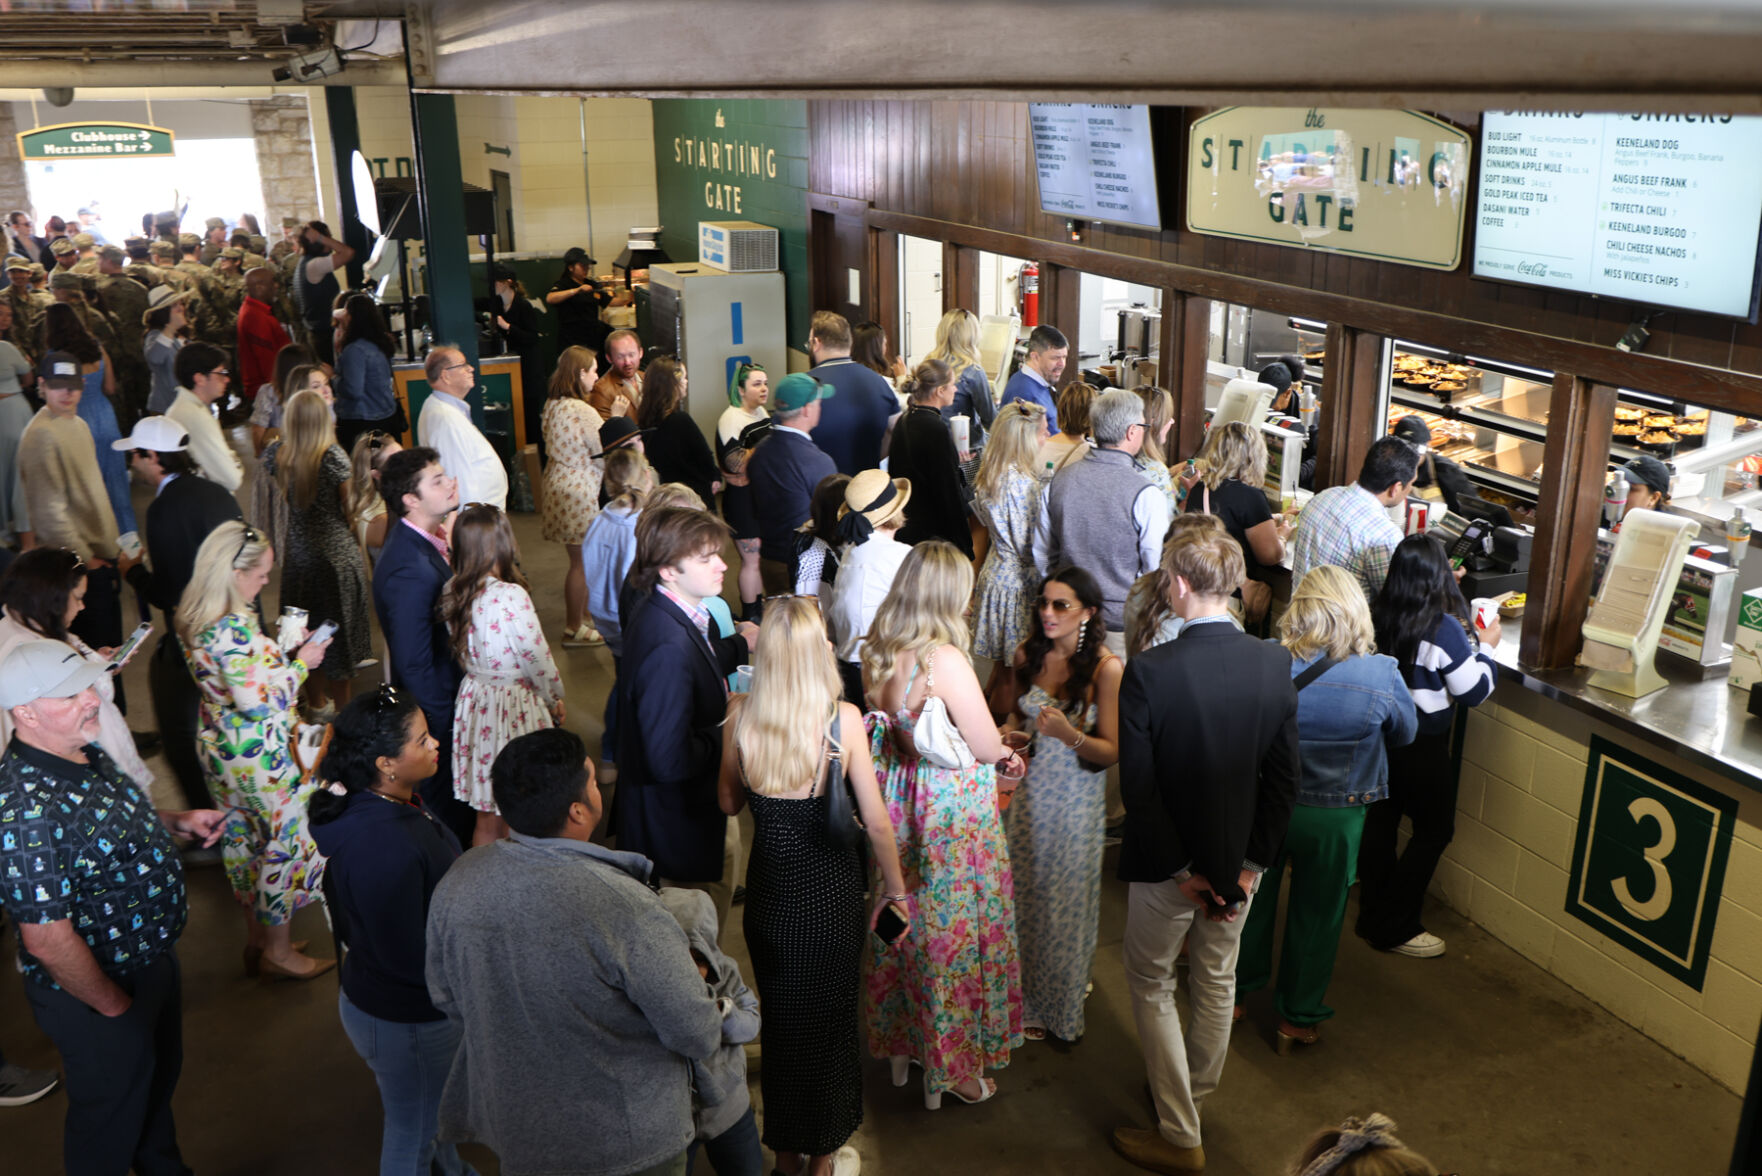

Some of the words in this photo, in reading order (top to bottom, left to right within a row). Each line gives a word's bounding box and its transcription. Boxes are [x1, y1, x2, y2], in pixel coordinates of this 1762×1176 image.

[1304, 108, 1326, 128] the
[71, 130, 137, 142] Clubhouse
[1488, 131, 1501, 141] BUD
[1503, 132, 1522, 141] LIGHT
[43, 143, 112, 154] Mezzanine
[114, 142, 138, 153] Bar
[1616, 137, 1660, 149] KEENELAND
[1662, 139, 1679, 150] DOG
[674, 137, 776, 178] STARTING
[1487, 145, 1518, 155] BOURBON
[1520, 147, 1538, 157] MULE
[1486, 159, 1520, 170] CINNAMON
[1522, 161, 1542, 172] APPLE
[1544, 163, 1562, 173] MULE
[1484, 174, 1500, 183] SOFT
[1502, 176, 1525, 186] DRINKS
[1613, 174, 1639, 184] ANGUS
[1641, 175, 1659, 186] BEEF
[1661, 177, 1688, 188] FRANK
[704, 181, 742, 214] GATE
[1484, 188, 1500, 198] GOLD
[1502, 190, 1518, 199] PEAK
[1520, 191, 1534, 201] ICED
[1536, 193, 1548, 202] TEA
[1268, 192, 1354, 232] GATE
[1483, 203, 1506, 213] DASANI
[1508, 205, 1530, 216] WATER
[1610, 202, 1644, 214] TRIFECTA
[1646, 205, 1667, 216] CHILI
[1482, 216, 1504, 227] COFFEE
[1608, 221, 1652, 234] KEENELAND
[1653, 226, 1687, 239] BURGOO
[1606, 240, 1625, 251] CHILI
[1627, 242, 1653, 254] CHEESE
[1655, 246, 1686, 259] NACHOS
[1604, 267, 1622, 279] MISS
[1624, 270, 1654, 283] VICKIE'S
[1655, 275, 1679, 287] CHIPS
[1610, 797, 1677, 921] 3
